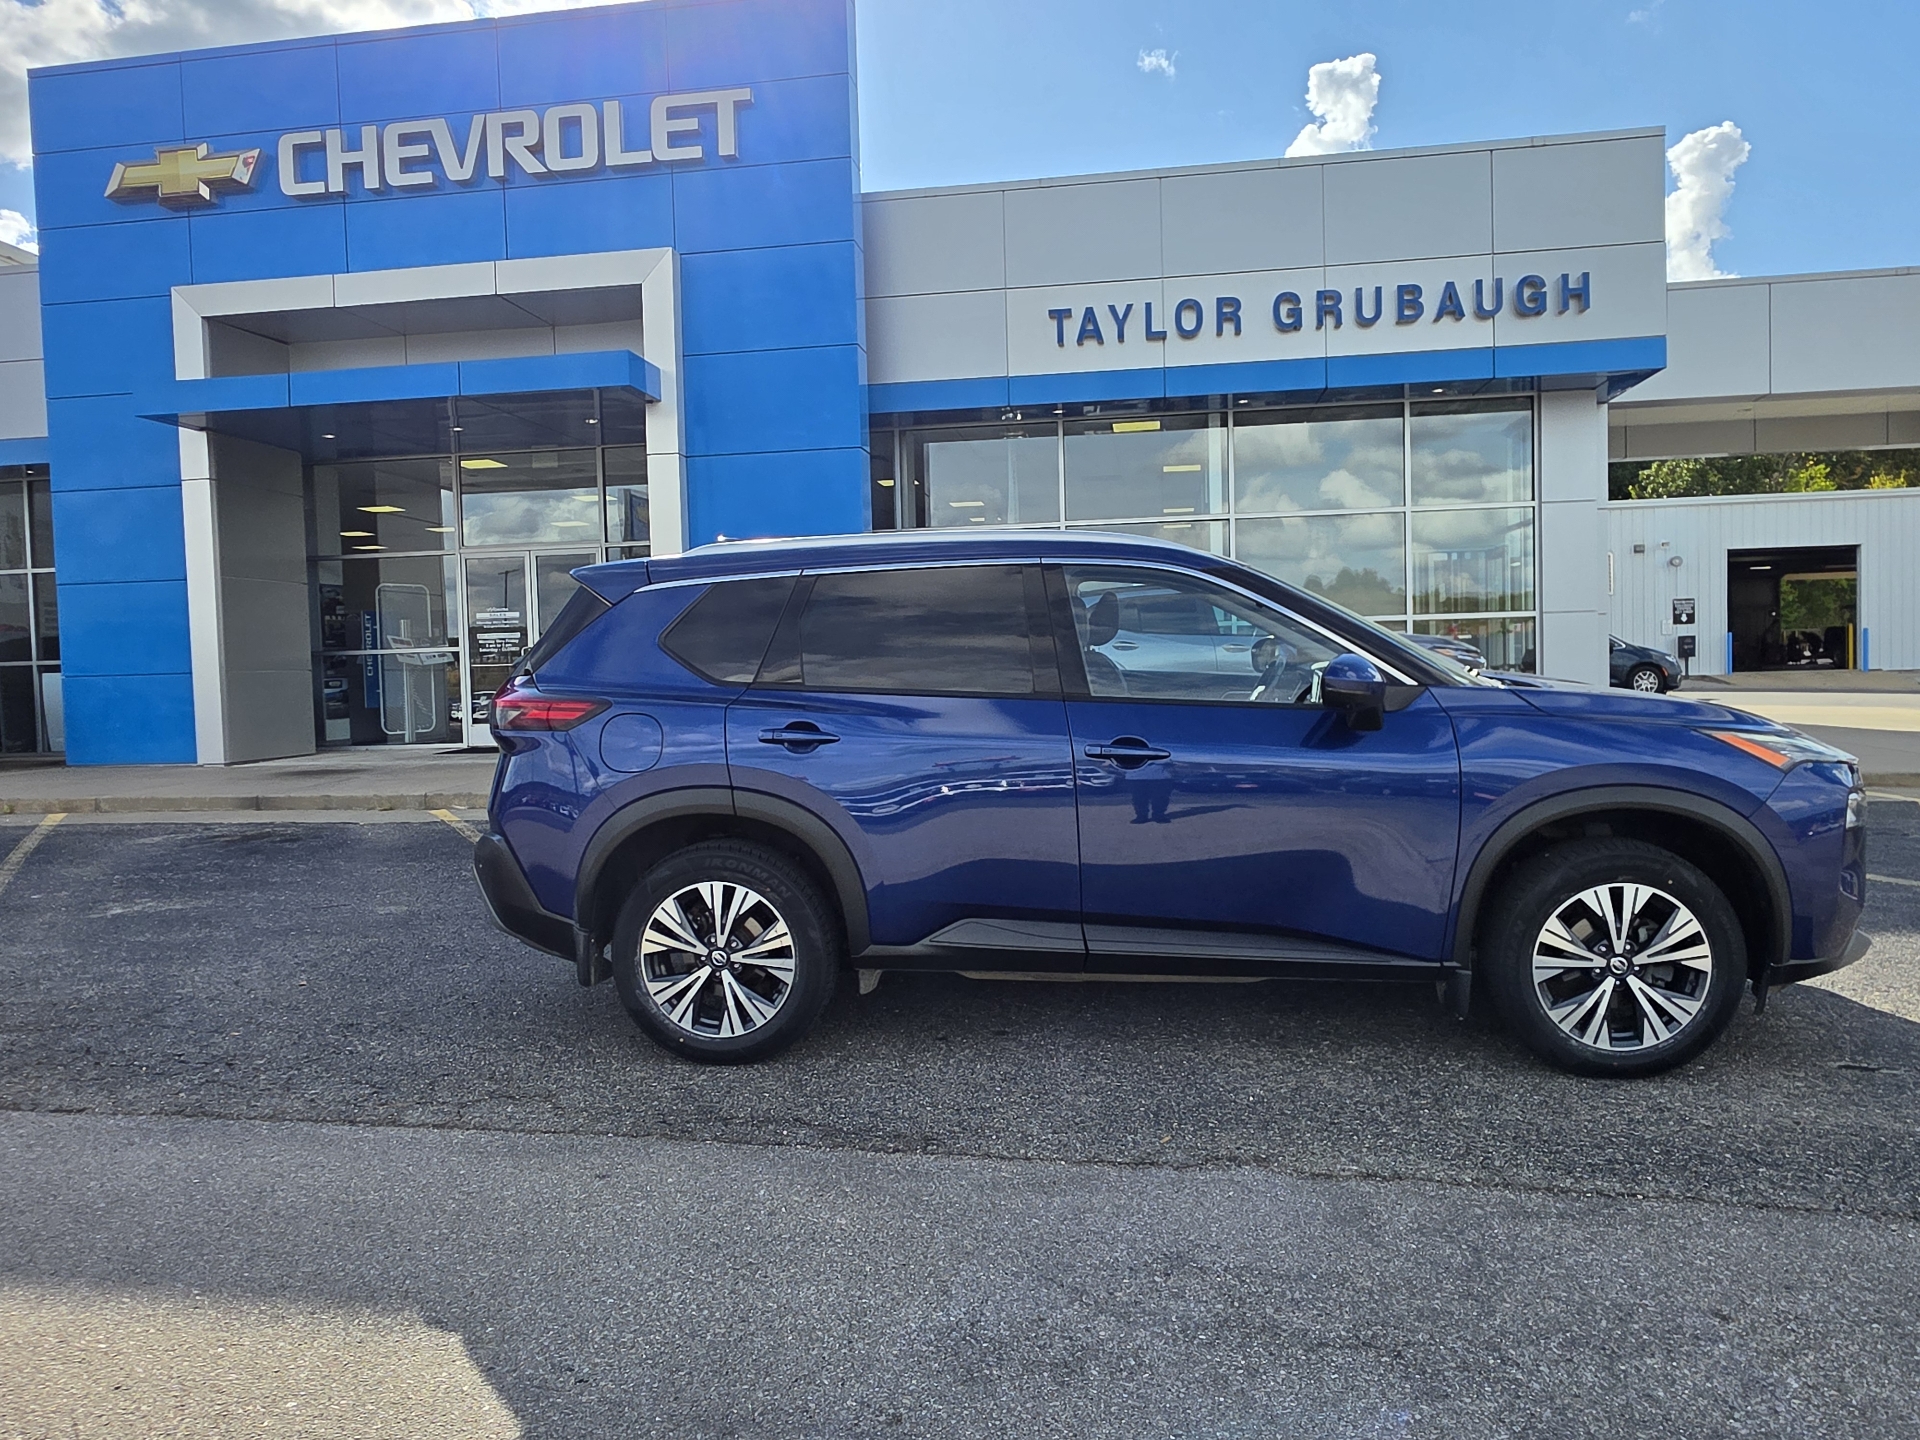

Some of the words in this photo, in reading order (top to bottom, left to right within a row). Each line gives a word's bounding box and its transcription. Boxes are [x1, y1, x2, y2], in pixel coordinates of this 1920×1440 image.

[279, 88, 752, 196] CHEVROLET
[1048, 296, 1242, 347] TAYLOR
[1272, 270, 1591, 333] GRUBAUGH
[705, 858, 792, 898] IRONMAN
